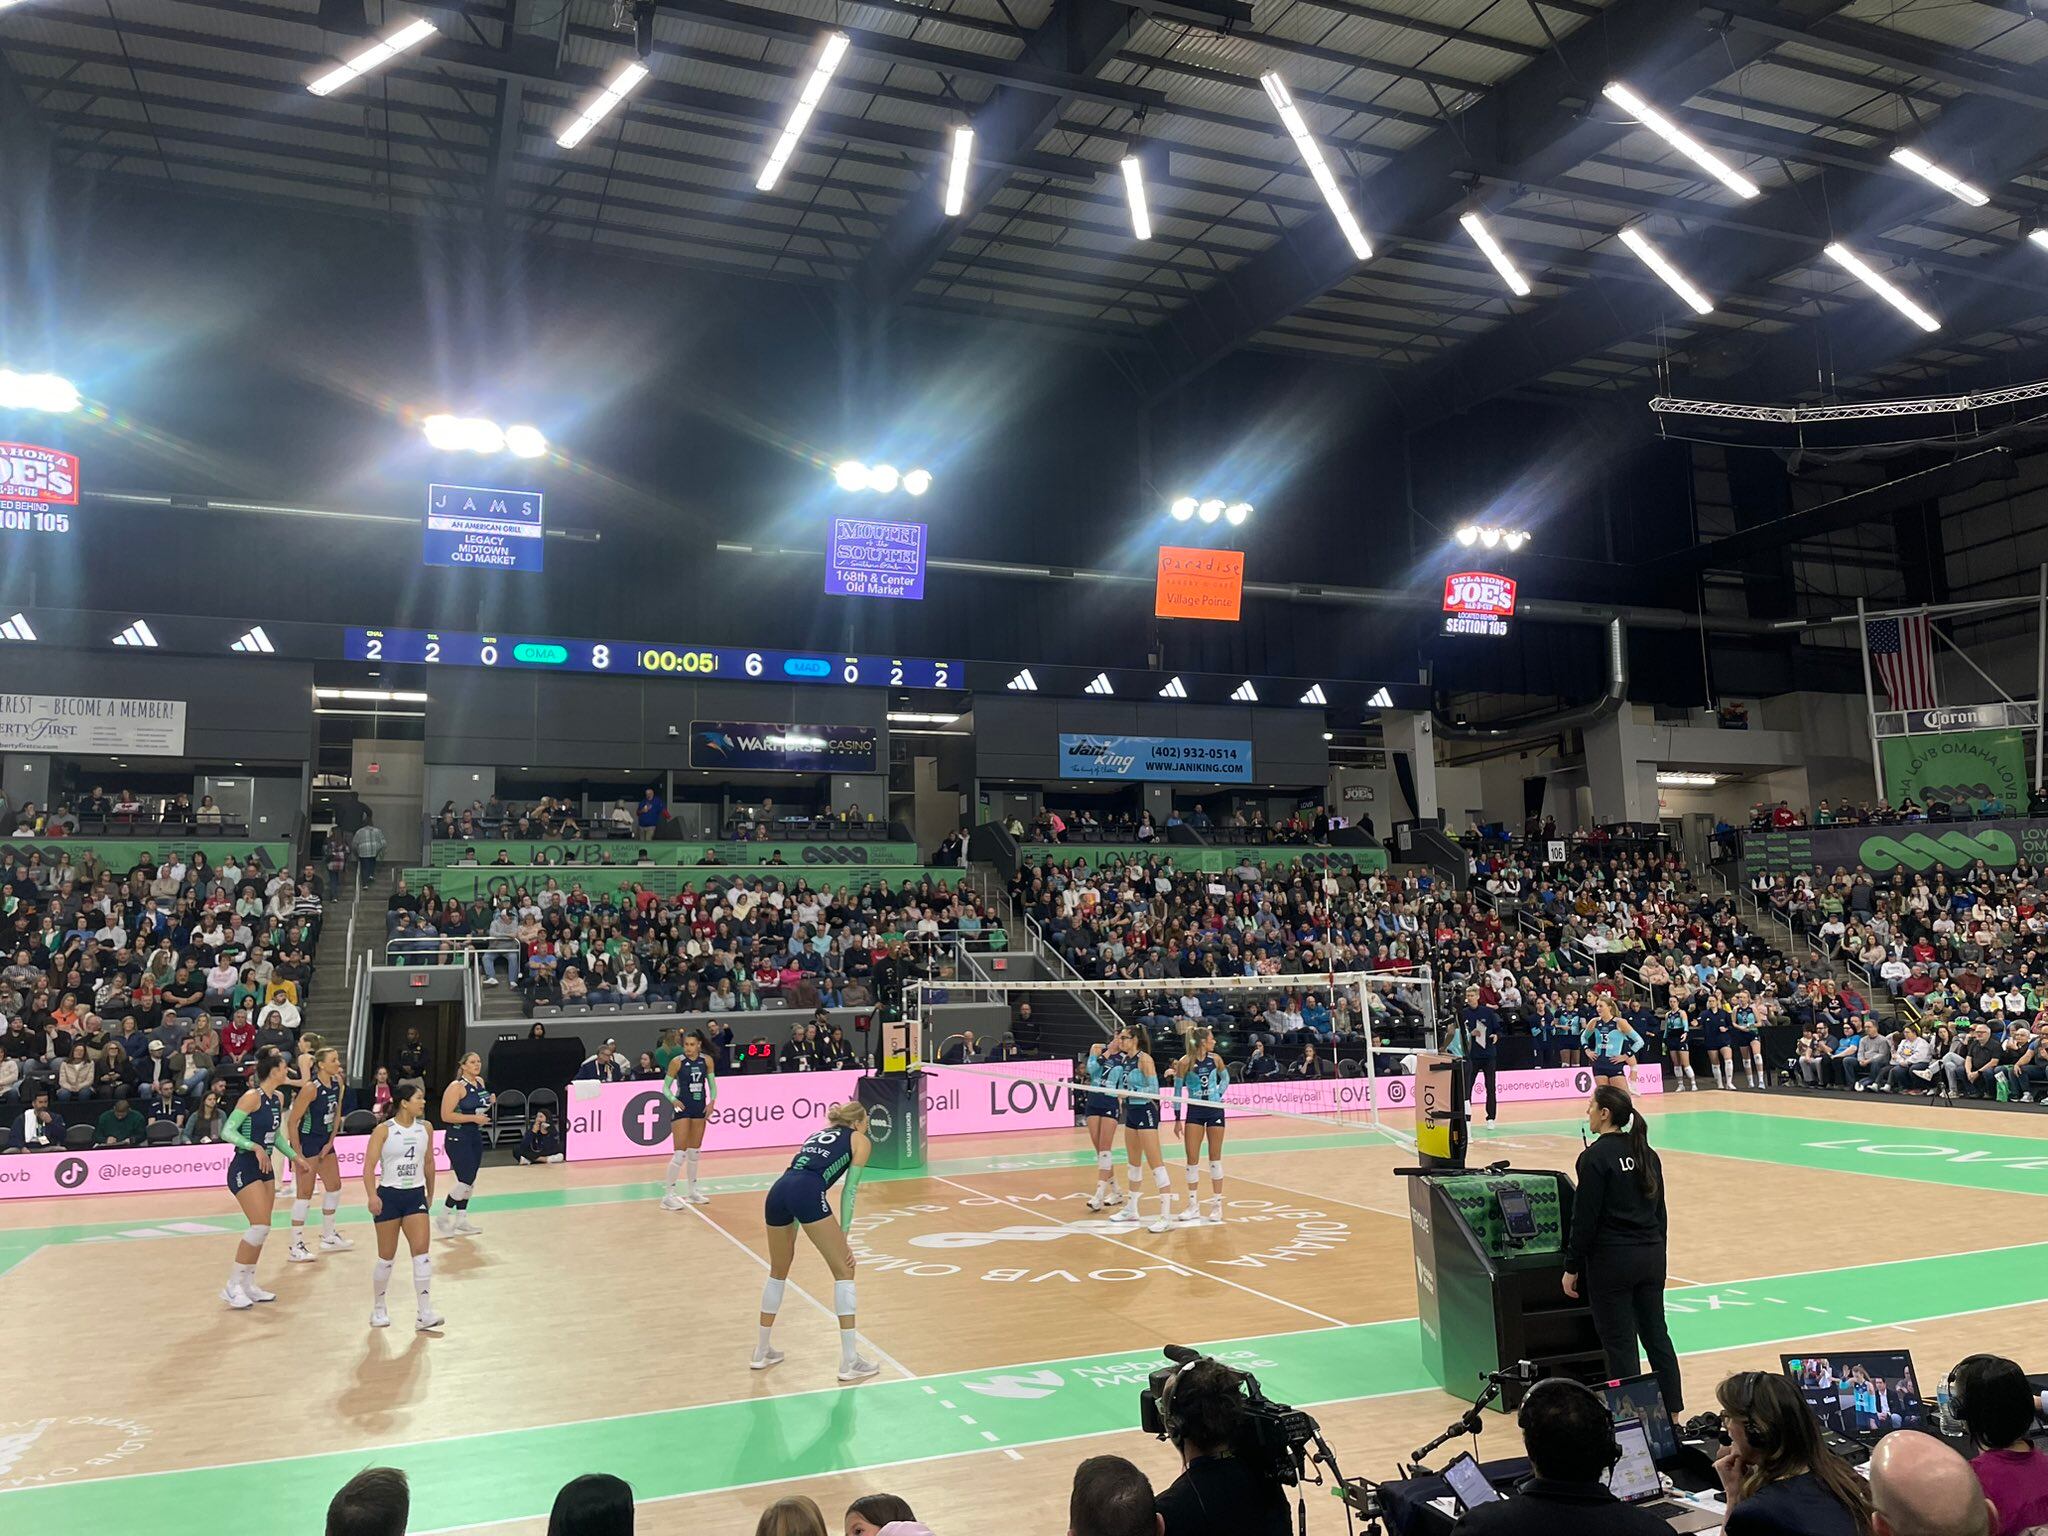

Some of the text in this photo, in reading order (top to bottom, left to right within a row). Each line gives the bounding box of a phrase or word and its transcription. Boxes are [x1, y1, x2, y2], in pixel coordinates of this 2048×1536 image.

[15, 501, 50, 512] BEHIND
[34, 512, 69, 533] 105
[465, 522, 501, 532] AMERICAN
[503, 525, 522, 533] GRILL
[465, 534, 504, 546] LEGACY
[837, 521, 919, 547] MOUTH
[458, 544, 509, 555] MIDTOWN
[837, 545, 917, 564] SOUTH
[451, 552, 516, 565] OLD MARKET
[836, 570, 915, 586] 168th & Center
[1451, 575, 1511, 590] OKLAHOMA
[846, 581, 904, 596] Old Market
[1167, 592, 1233, 607] Village Pointe
[1446, 618, 1508, 636] SECTION 105
[366, 639, 382, 660] 2
[424, 642, 440, 662] 2
[480, 645, 498, 666] 0
[524, 647, 556, 660] OMA
[591, 643, 609, 669] 8
[643, 649, 713, 673] 00:05
[745, 653, 763, 677] 6
[843, 664, 859, 684] 0
[890, 667, 904, 686] 2
[935, 669, 948, 688] 2
[54, 698, 102, 716] BECOME
[107, 700, 115, 717] A
[120, 701, 174, 719] MEMBER!
[828, 739, 872, 750] CASINO
[1069, 739, 1111, 757] Jani
[1152, 746, 1237, 760] (402) 932-0514
[1906, 748, 1938, 776] LOVB
[1942, 743, 1997, 767] OMAHA
[1145, 762, 1243, 773] WWW.JANIKING.COM
[1551, 847, 1564, 860] 106
[690, 1072, 702, 1082] 17
[1474, 1078, 1570, 1094] @gueonevolleyball
[1253, 1094, 1274, 1105] One
[1275, 1090, 1321, 1104] Volleyball
[1424, 1085, 1435, 1130] LOVB
[272, 1115, 280, 1130] 5
[705, 1103, 784, 1128] eague
[803, 1130, 841, 1146] 26
[404, 1145, 415, 1160] 4
[0, 1168, 31, 1183] ovb
[980, 1265, 1193, 1283] LOVB
[1071, 1349, 1259, 1378] Nebrka
[1091, 1356, 1279, 1388] Mene
